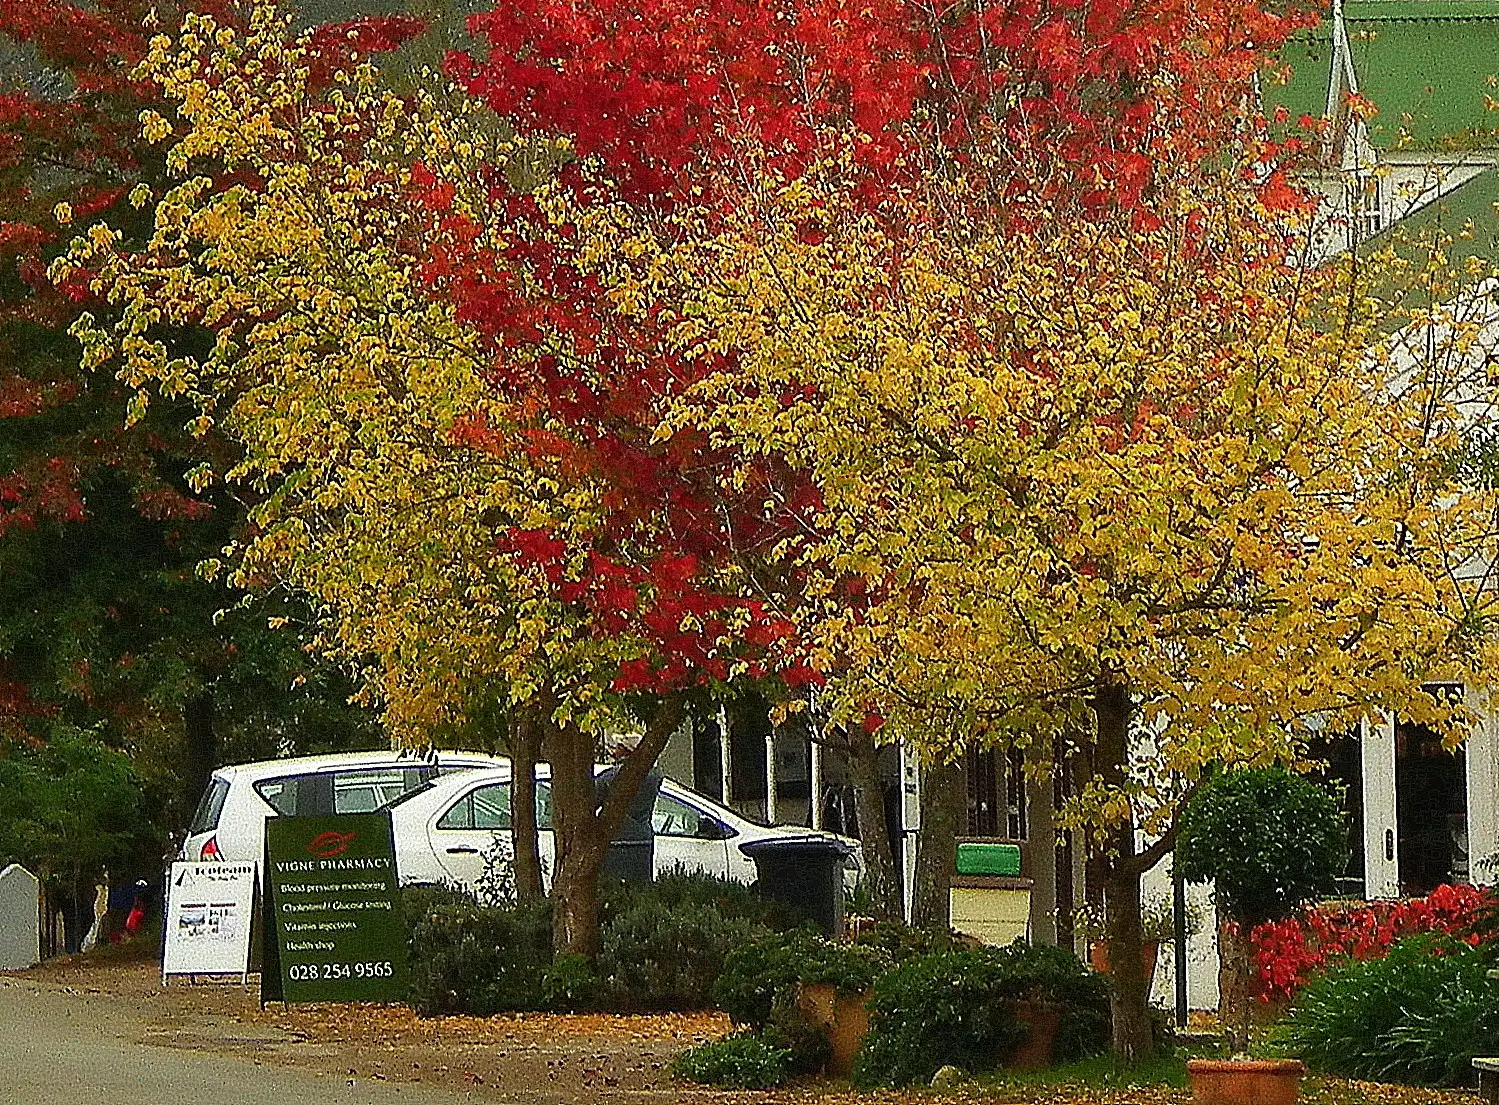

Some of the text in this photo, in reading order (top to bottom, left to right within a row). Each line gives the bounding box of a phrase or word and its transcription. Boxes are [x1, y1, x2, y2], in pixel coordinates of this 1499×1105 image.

[276, 857, 392, 873] VIGNE PHARMACY
[280, 883, 306, 893] Blood
[289, 960, 393, 981] 028 254 9565
